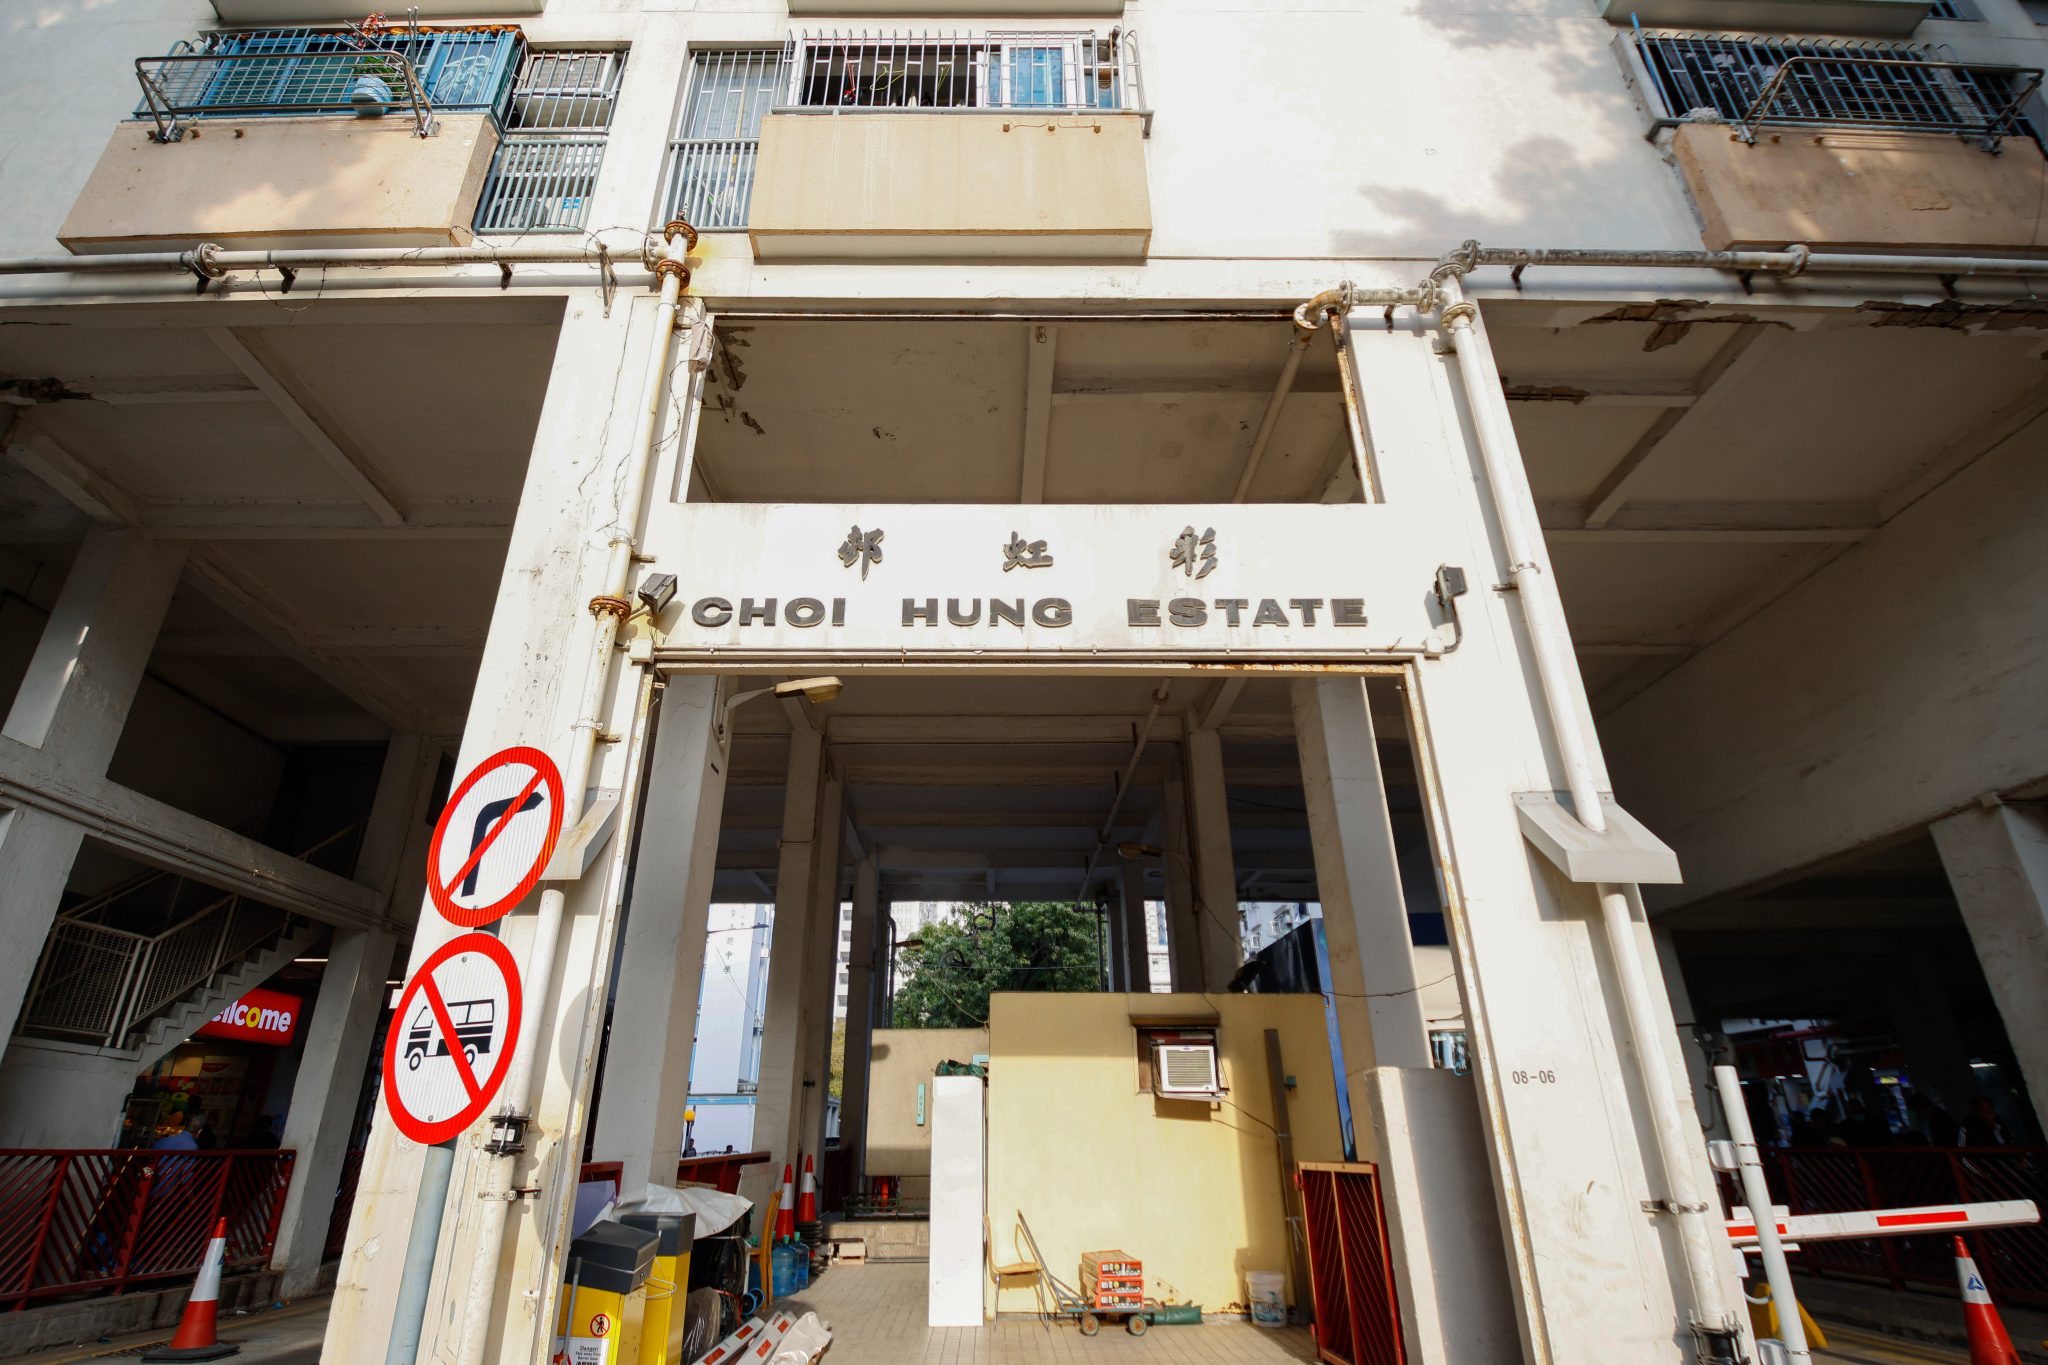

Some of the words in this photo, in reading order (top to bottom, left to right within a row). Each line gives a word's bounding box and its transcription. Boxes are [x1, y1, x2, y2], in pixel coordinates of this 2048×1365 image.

[692, 597, 846, 627] CHOI
[902, 598, 1072, 627] HUNG
[1127, 598, 1368, 627] ESTATE
[1512, 1070, 1556, 1084] 08-06
